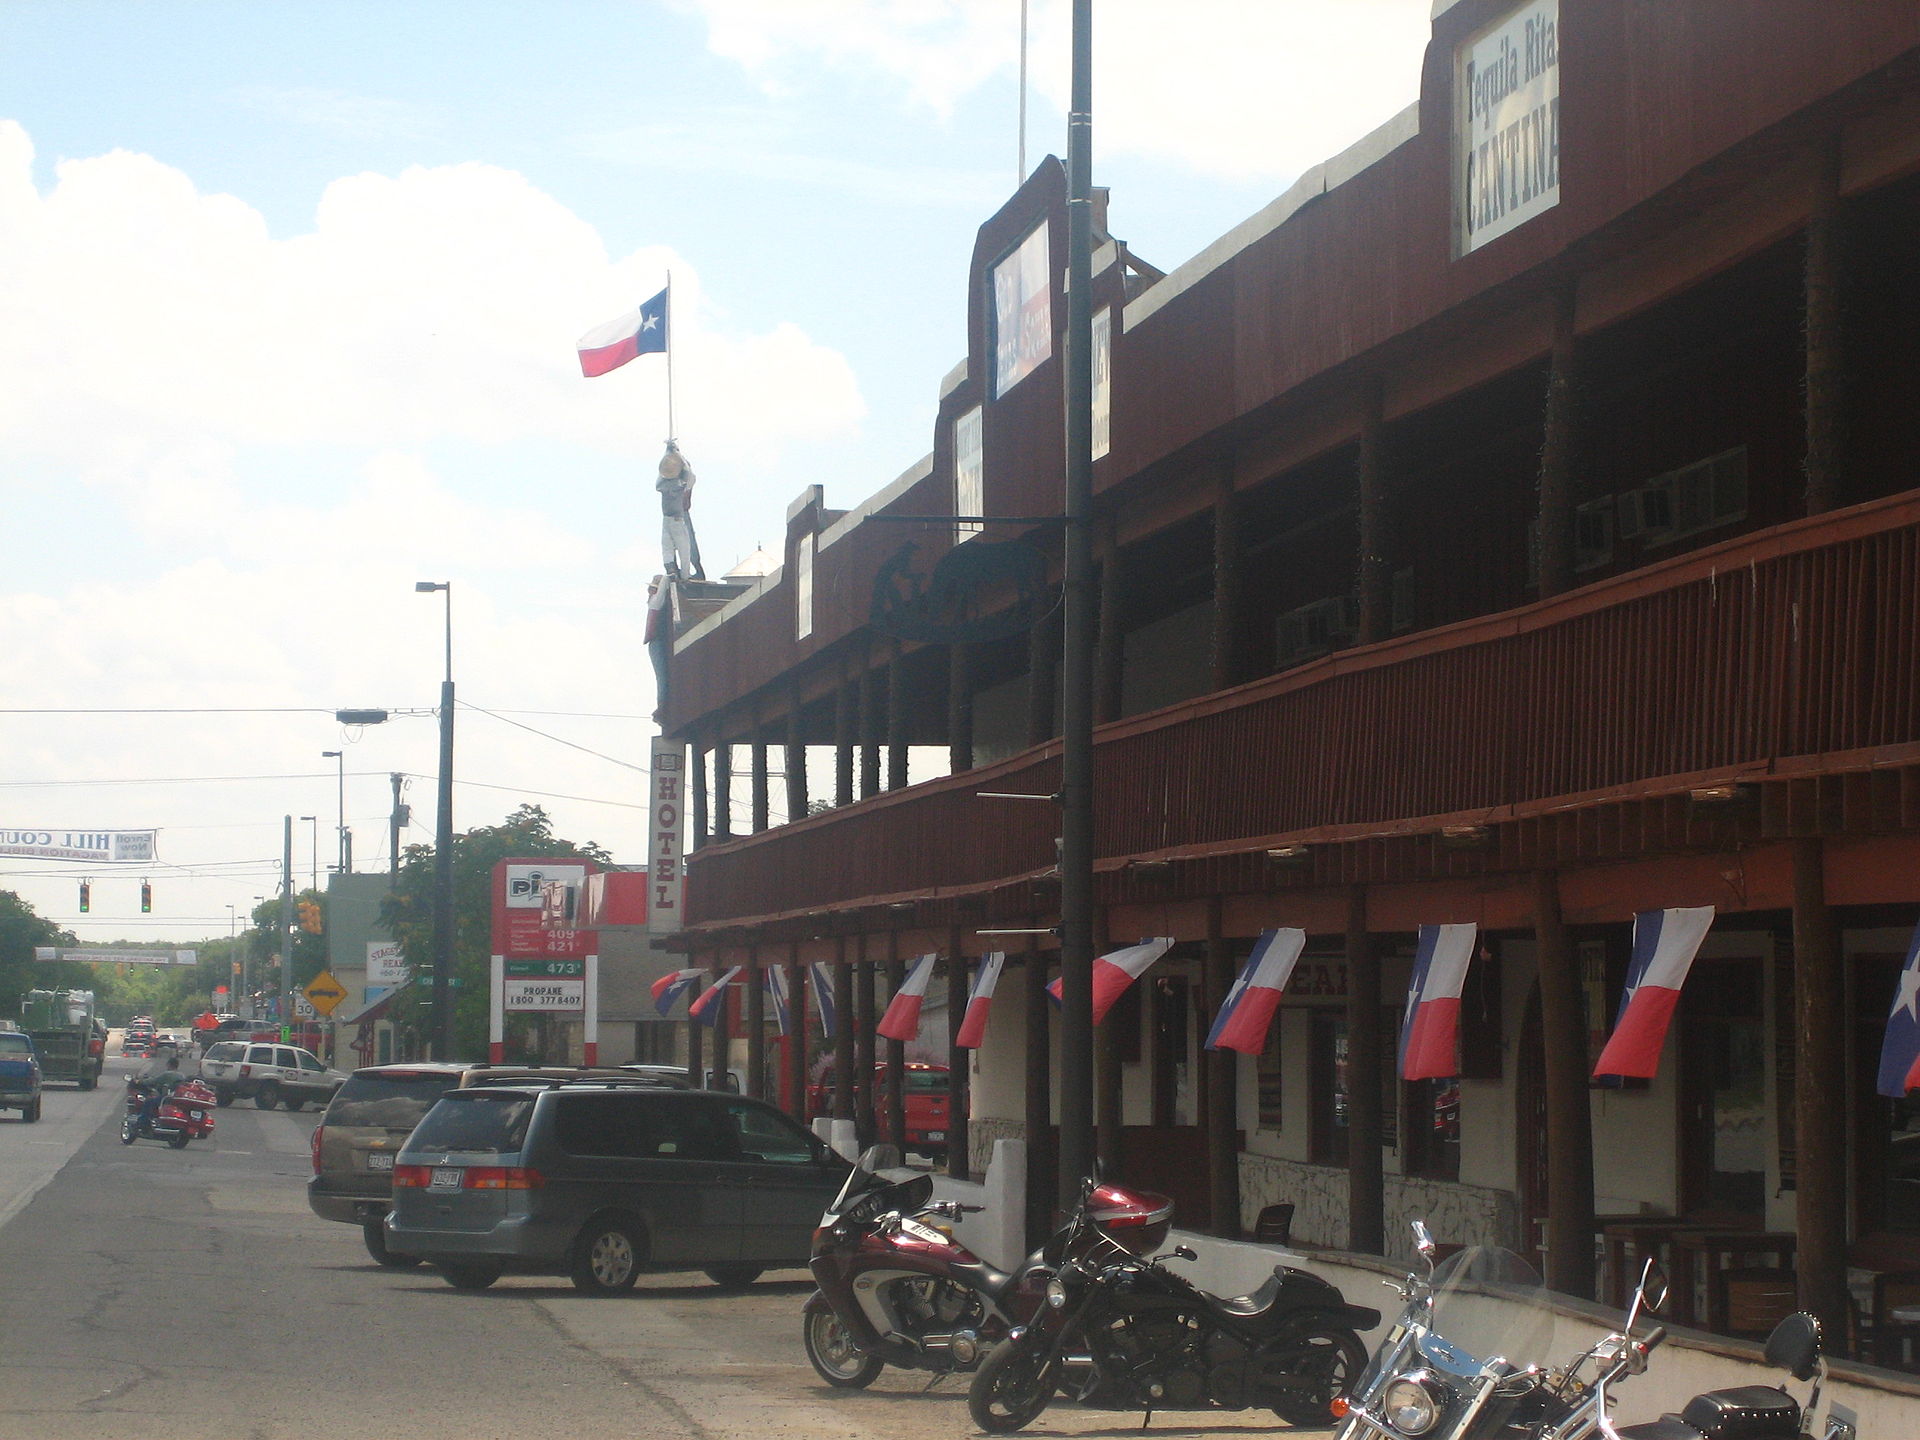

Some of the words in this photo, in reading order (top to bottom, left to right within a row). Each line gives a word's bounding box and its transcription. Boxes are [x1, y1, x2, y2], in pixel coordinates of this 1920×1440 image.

[1466, 35, 1518, 130] Tequila
[1466, 97, 1559, 236] CANTINA
[656, 777, 677, 908] HOTEL
[297, 1005, 313, 1014] 30
[523, 987, 562, 995] PROPANE
